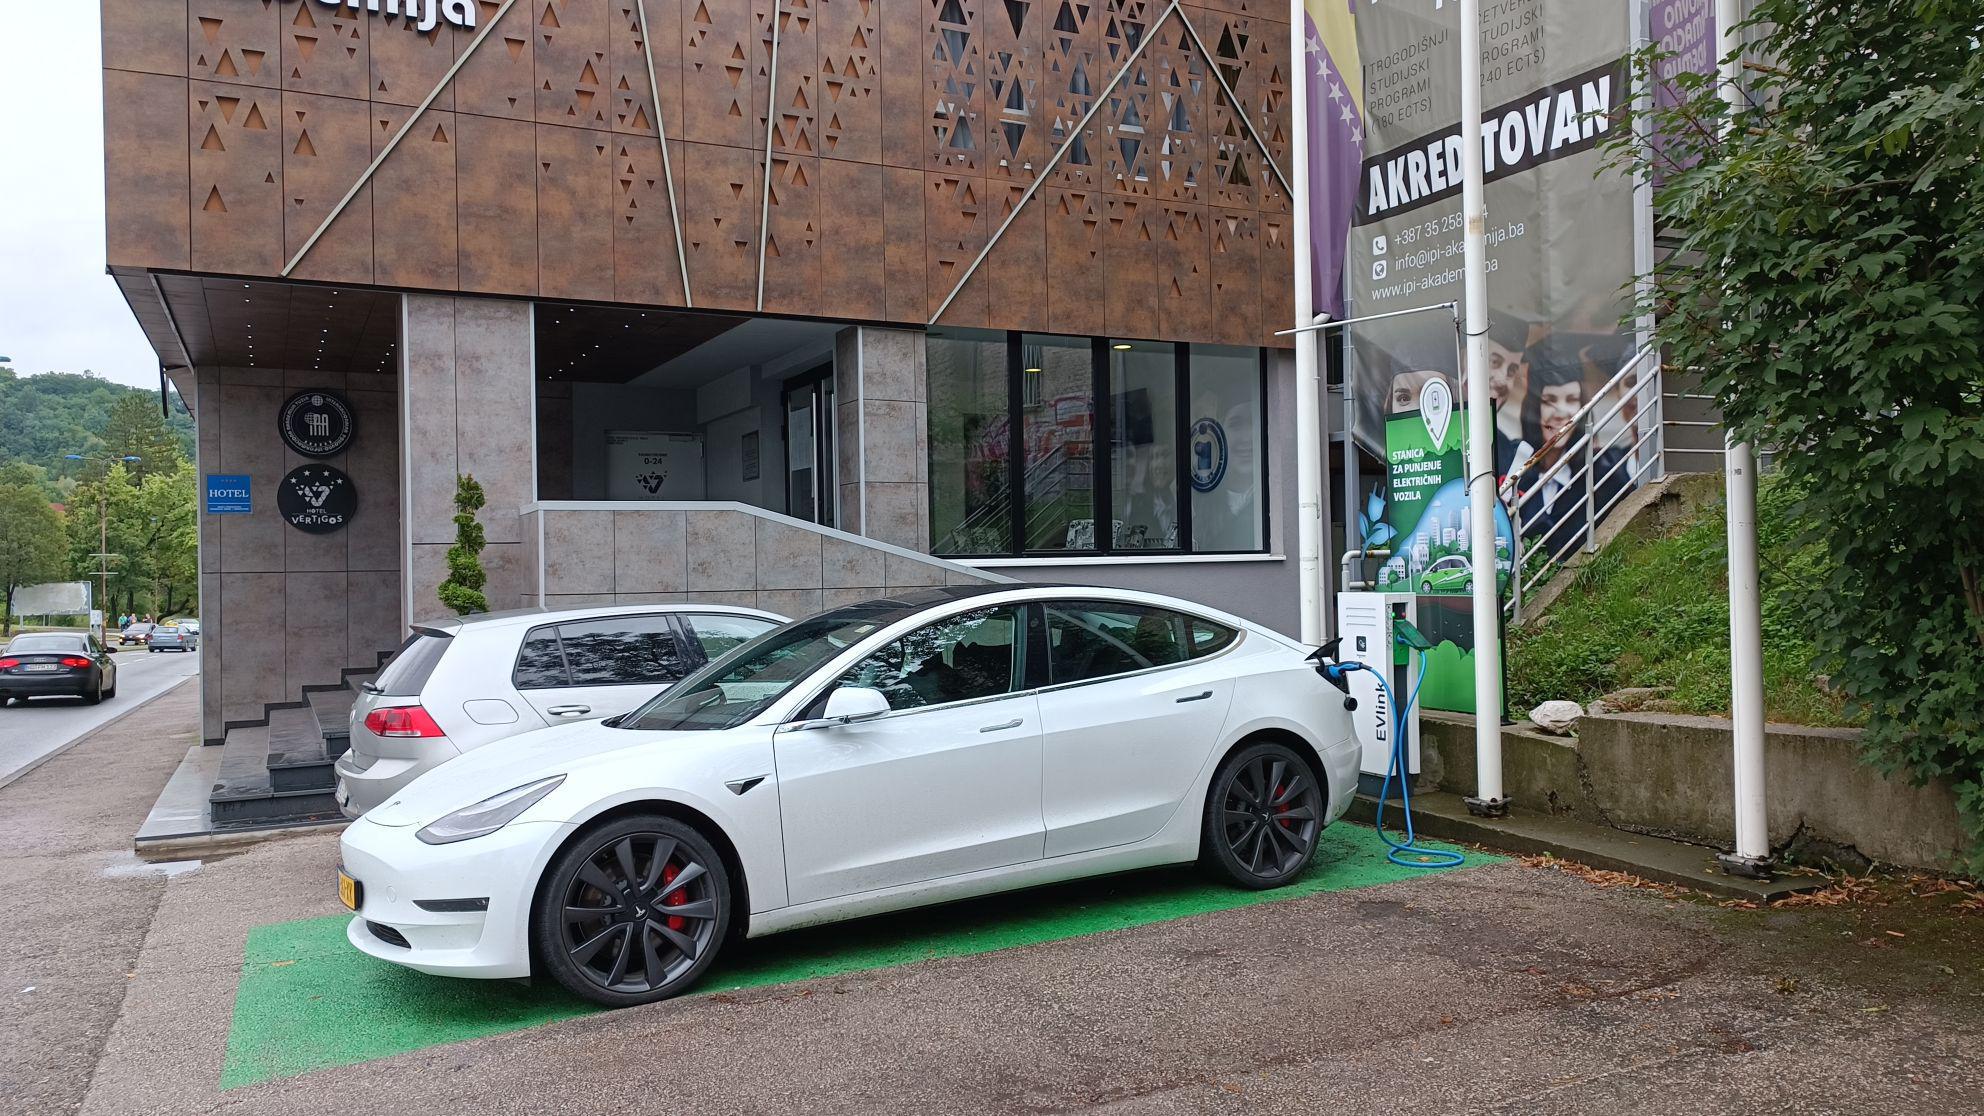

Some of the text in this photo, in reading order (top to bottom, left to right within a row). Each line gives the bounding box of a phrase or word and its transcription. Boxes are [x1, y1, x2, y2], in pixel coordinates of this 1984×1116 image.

[1481, 3, 1543, 44] TUDIJSKI
[1369, 28, 1449, 76] TROGODIŠNJI
[1481, 25, 1544, 65] ROGRAMI
[1370, 57, 1430, 95] STUDIJSKI
[1480, 46, 1546, 88] 240 ECTS)
[1370, 77, 1431, 118] PROGRAMI
[1371, 96, 1433, 136] (180 ECTS)
[1368, 75, 1611, 215] AKREDTOVAN
[1394, 225, 1422, 246] +387
[1424, 221, 1439, 238] 35
[1441, 212, 1463, 232] 258
[1392, 448, 1424, 460] STANICA
[1392, 460, 1442, 474] ZA PUNJENJE
[209, 489, 249, 498] HOTEL
[1393, 474, 1442, 488] ELEKTRIČNIH
[1393, 491, 1421, 501] VOZILA
[291, 515, 343, 525] VERTIGOS
[1375, 682, 1387, 742] EVlink
